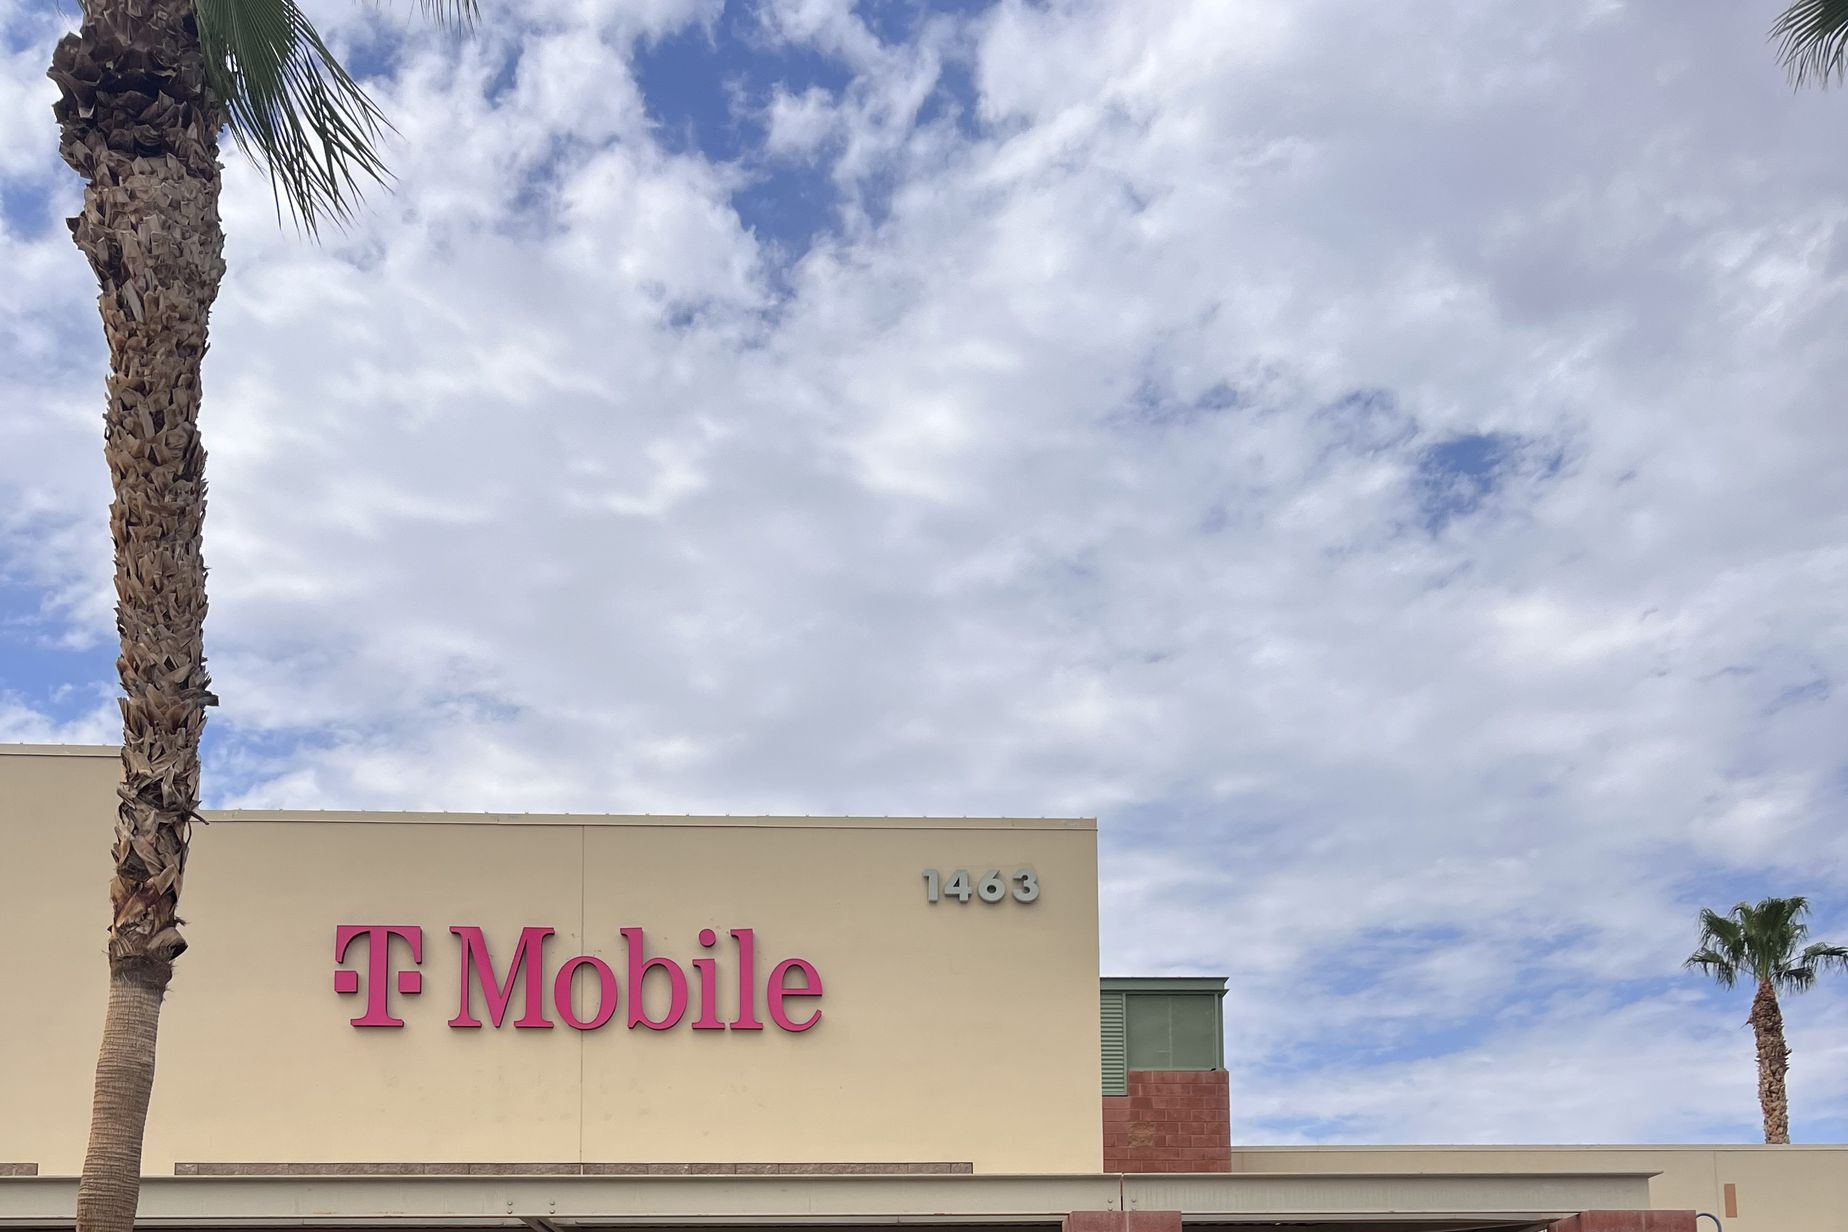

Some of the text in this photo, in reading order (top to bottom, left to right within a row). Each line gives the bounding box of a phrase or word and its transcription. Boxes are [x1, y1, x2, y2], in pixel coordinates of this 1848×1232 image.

[922, 869, 1040, 904] 1463
[335, 925, 823, 1032] T Mobile
